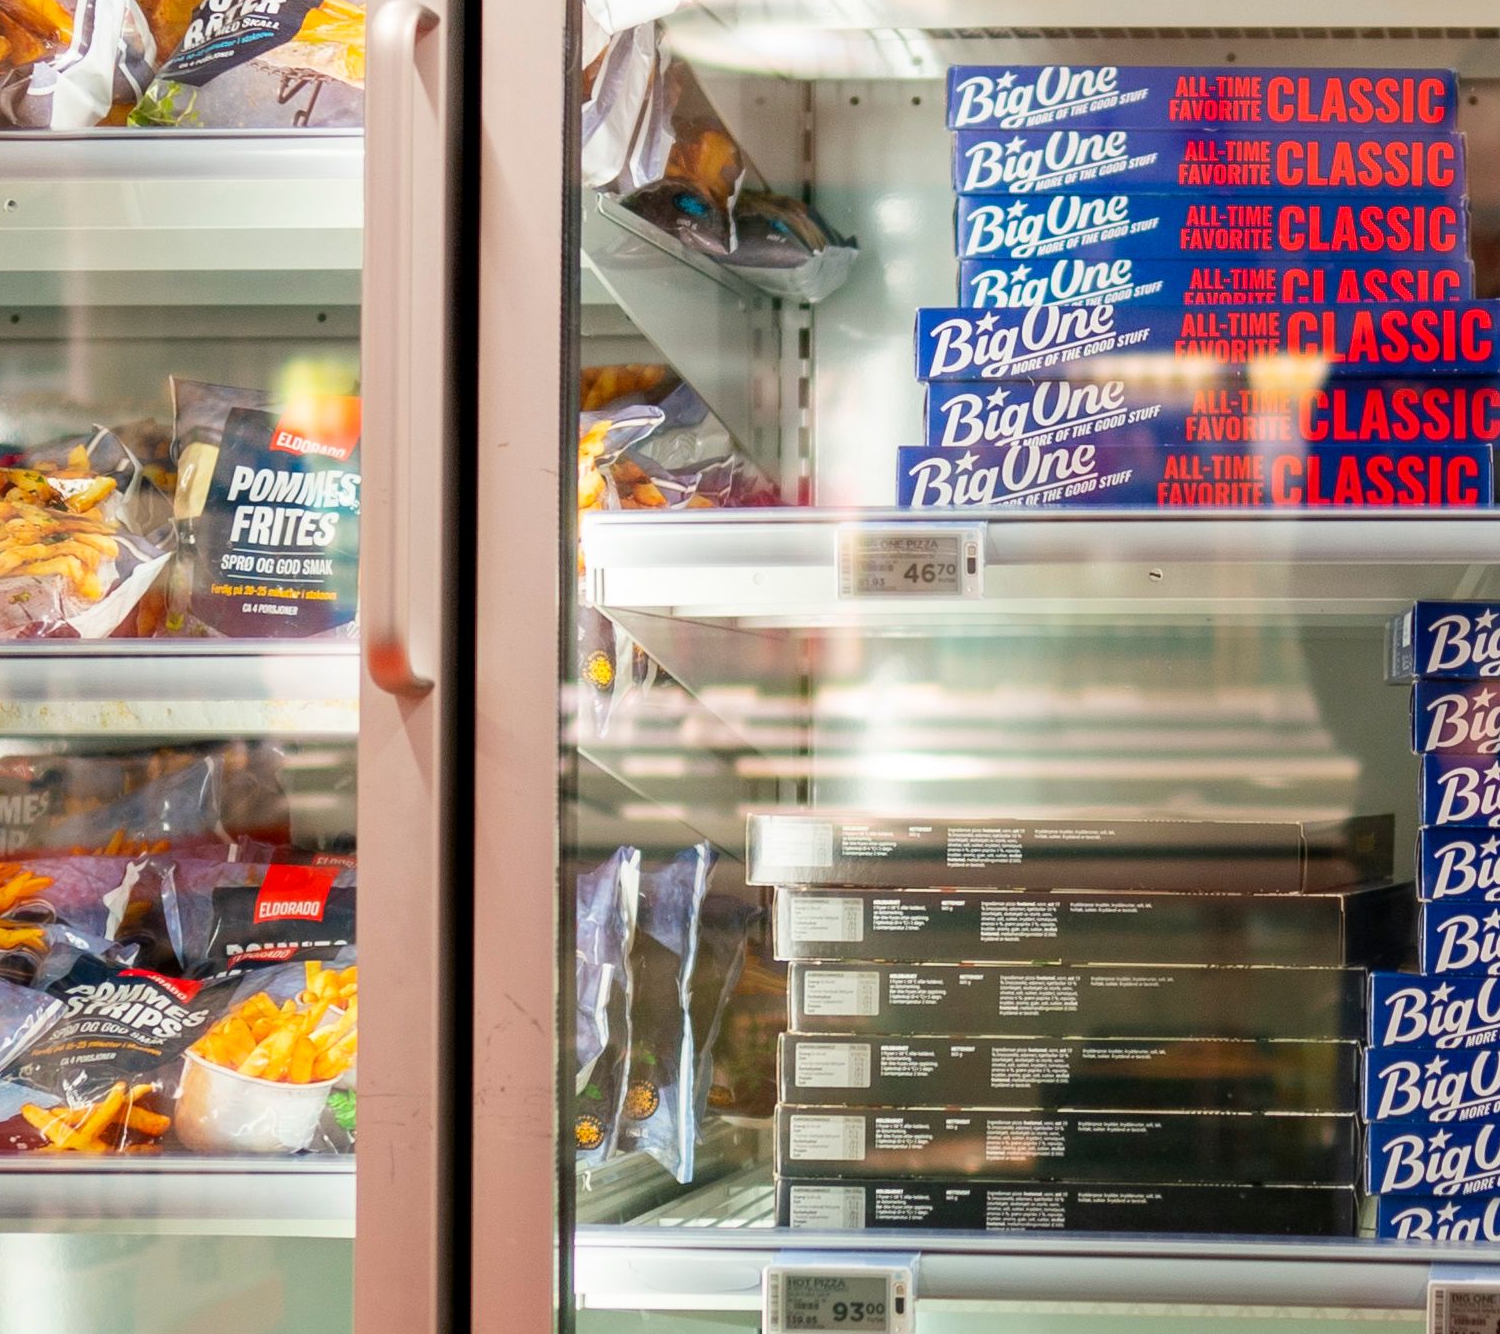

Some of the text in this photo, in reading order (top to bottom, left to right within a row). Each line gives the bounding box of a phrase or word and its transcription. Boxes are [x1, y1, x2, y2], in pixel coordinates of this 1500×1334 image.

[1175, 77, 1261, 98] ALL-TIME
[1169, 99, 1261, 121] FAVORITE
[1268, 77, 1445, 124] CLASSIC
[227, 465, 362, 508] POMMES
[230, 506, 340, 546] FRITES
[221, 554, 333, 576] SPRØ OG GOD SMAK
[258, 901, 322, 920] ELDORADO
